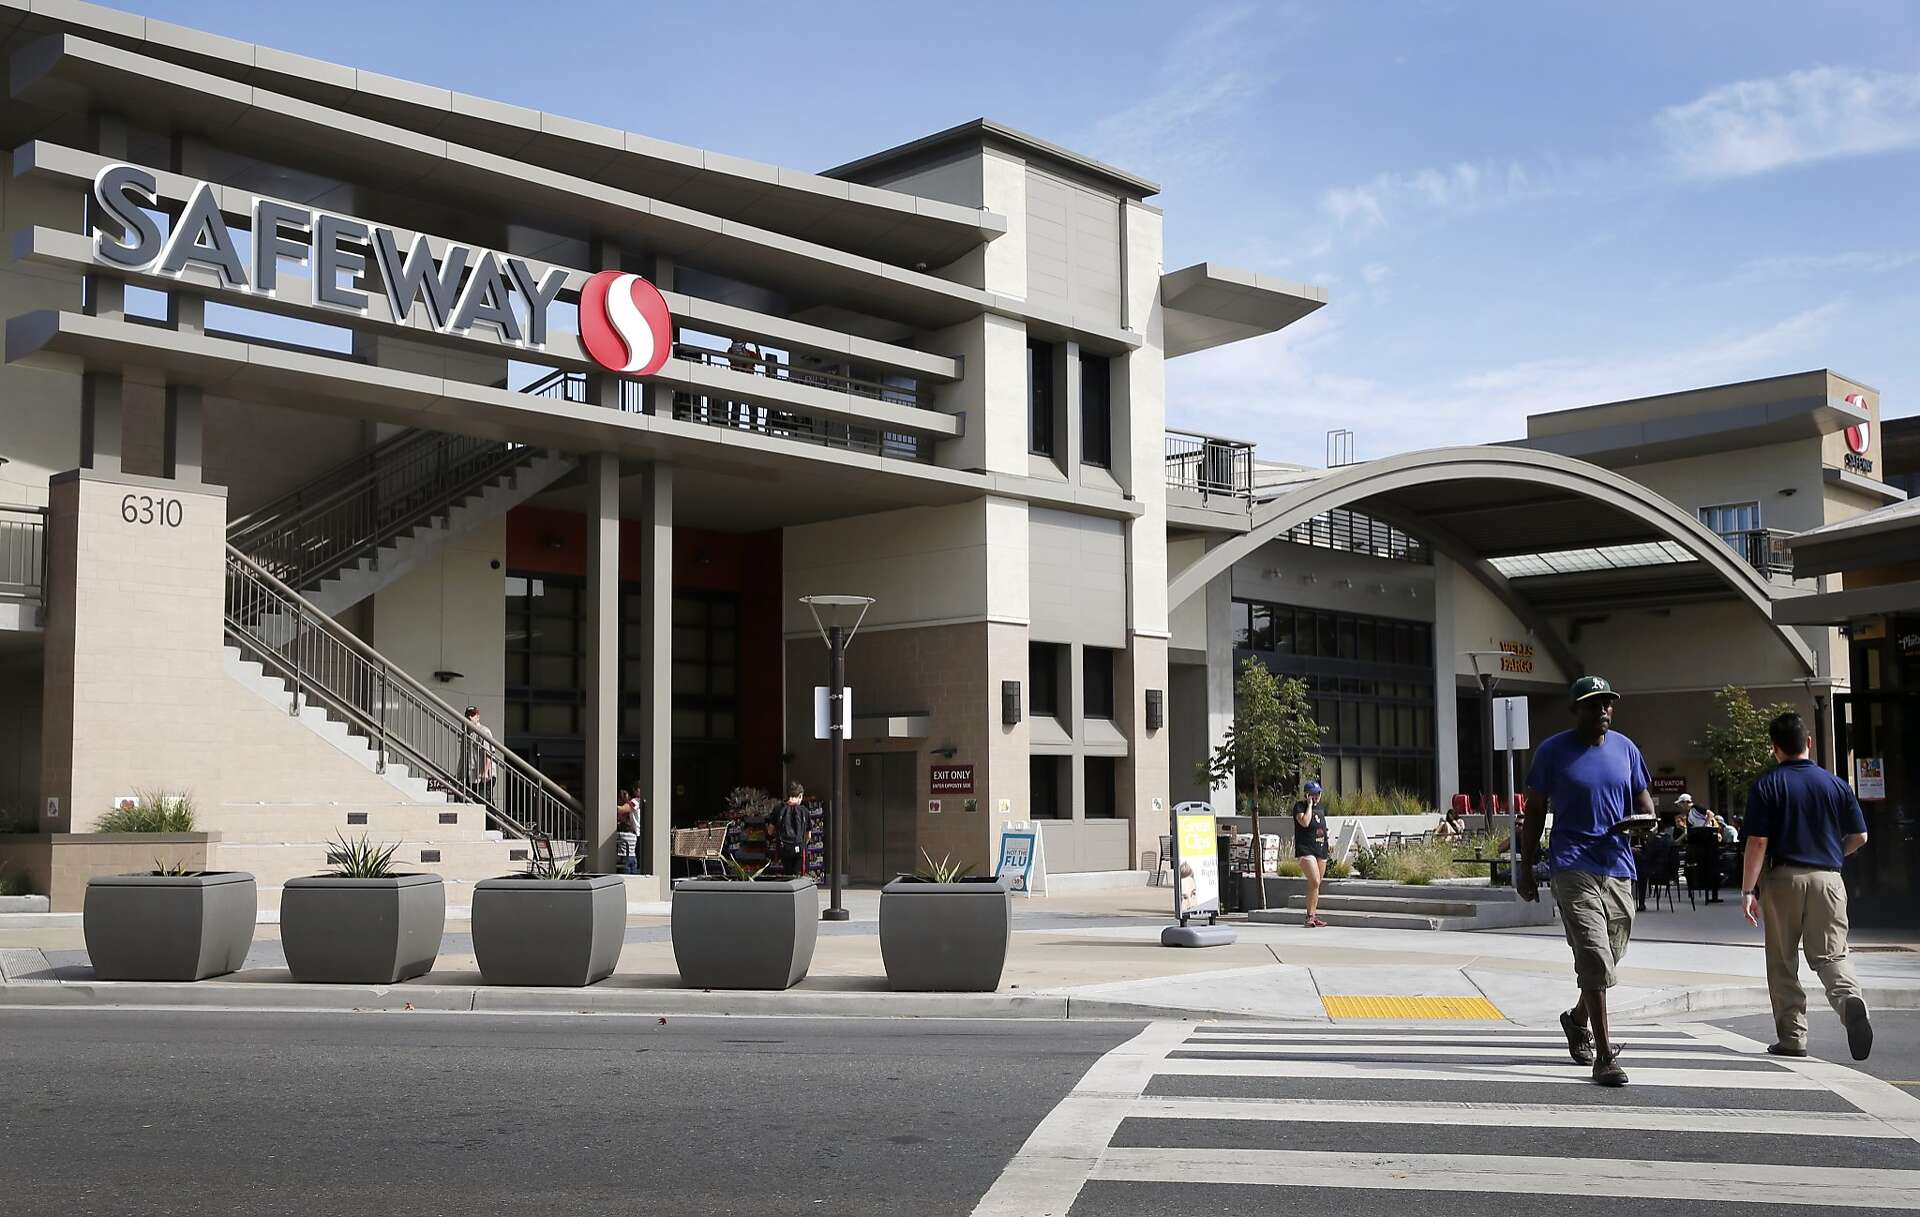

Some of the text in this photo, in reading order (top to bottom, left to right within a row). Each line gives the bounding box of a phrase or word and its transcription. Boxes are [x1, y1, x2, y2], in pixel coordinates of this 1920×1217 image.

[93, 163, 570, 350] SAFEWAY
[121, 494, 183, 527] 6310
[1499, 640, 1536, 657] WELLS
[1500, 656, 1536, 673] FARGO
[933, 770, 971, 780] EXIT ONLY
[1004, 855, 1028, 867] FLU
